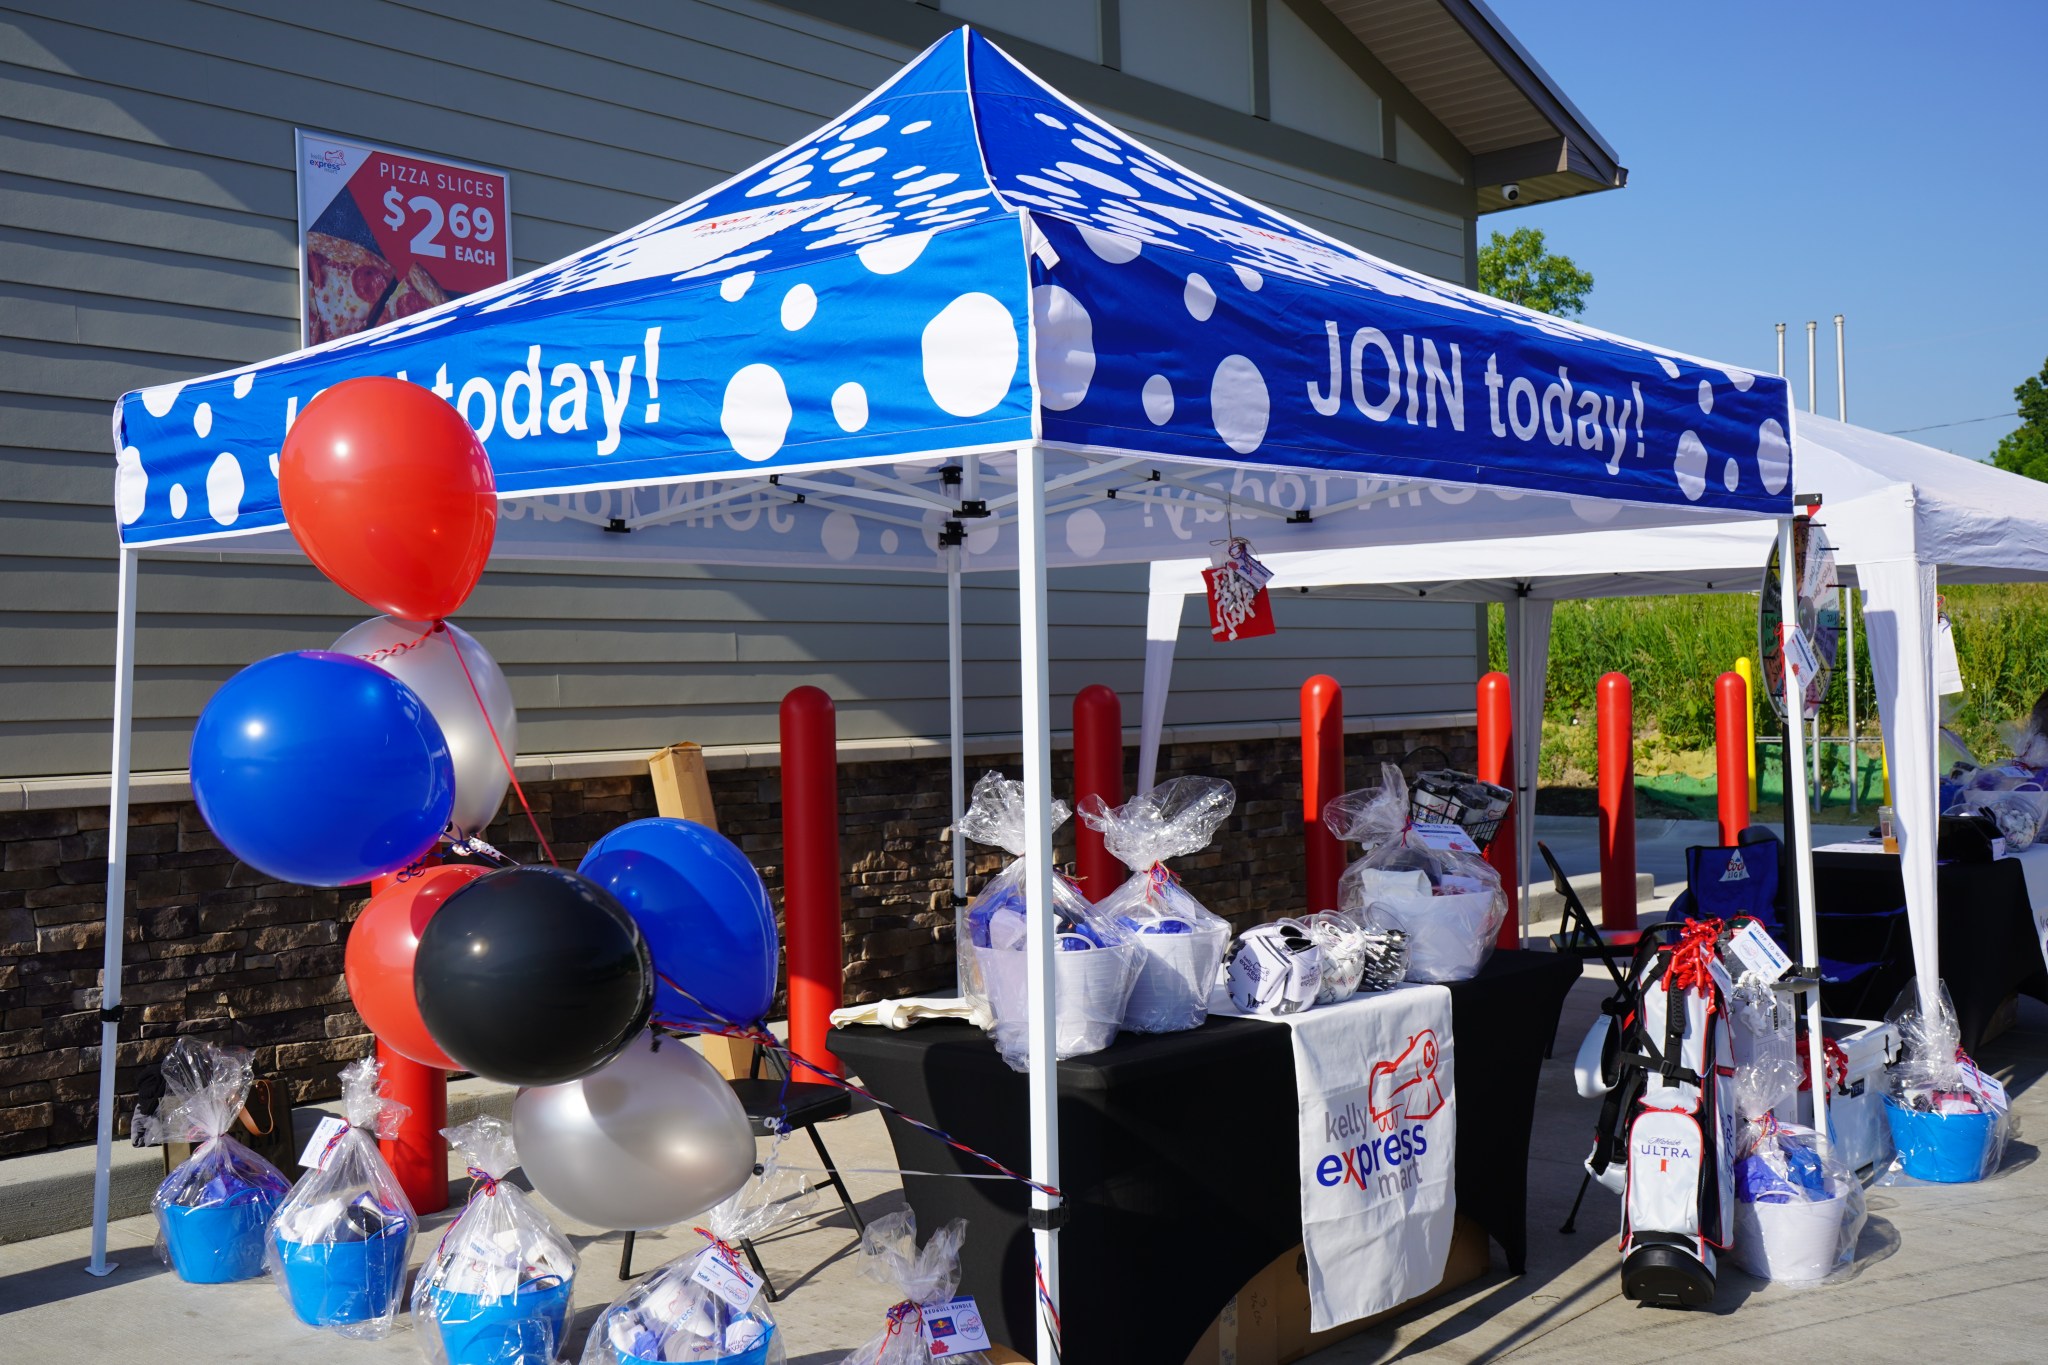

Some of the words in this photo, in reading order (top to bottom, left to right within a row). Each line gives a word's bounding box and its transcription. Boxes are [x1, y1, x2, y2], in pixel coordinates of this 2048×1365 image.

[310, 160, 341, 171] express
[380, 162, 430, 186] PIZZA
[437, 174, 494, 199] SLICES
[455, 246, 496, 266] EACH
[1306, 320, 1465, 432] JOIN
[1485, 353, 1645, 476] today!
[1775, 951, 1786, 963] WIN
[1240, 959, 1261, 982] express
[1424, 1044, 1434, 1062] K
[1324, 1102, 1368, 1143] kelly
[1316, 1124, 1428, 1191] express
[1641, 1144, 1692, 1158] ULTRA
[1377, 1155, 1424, 1199] mart
